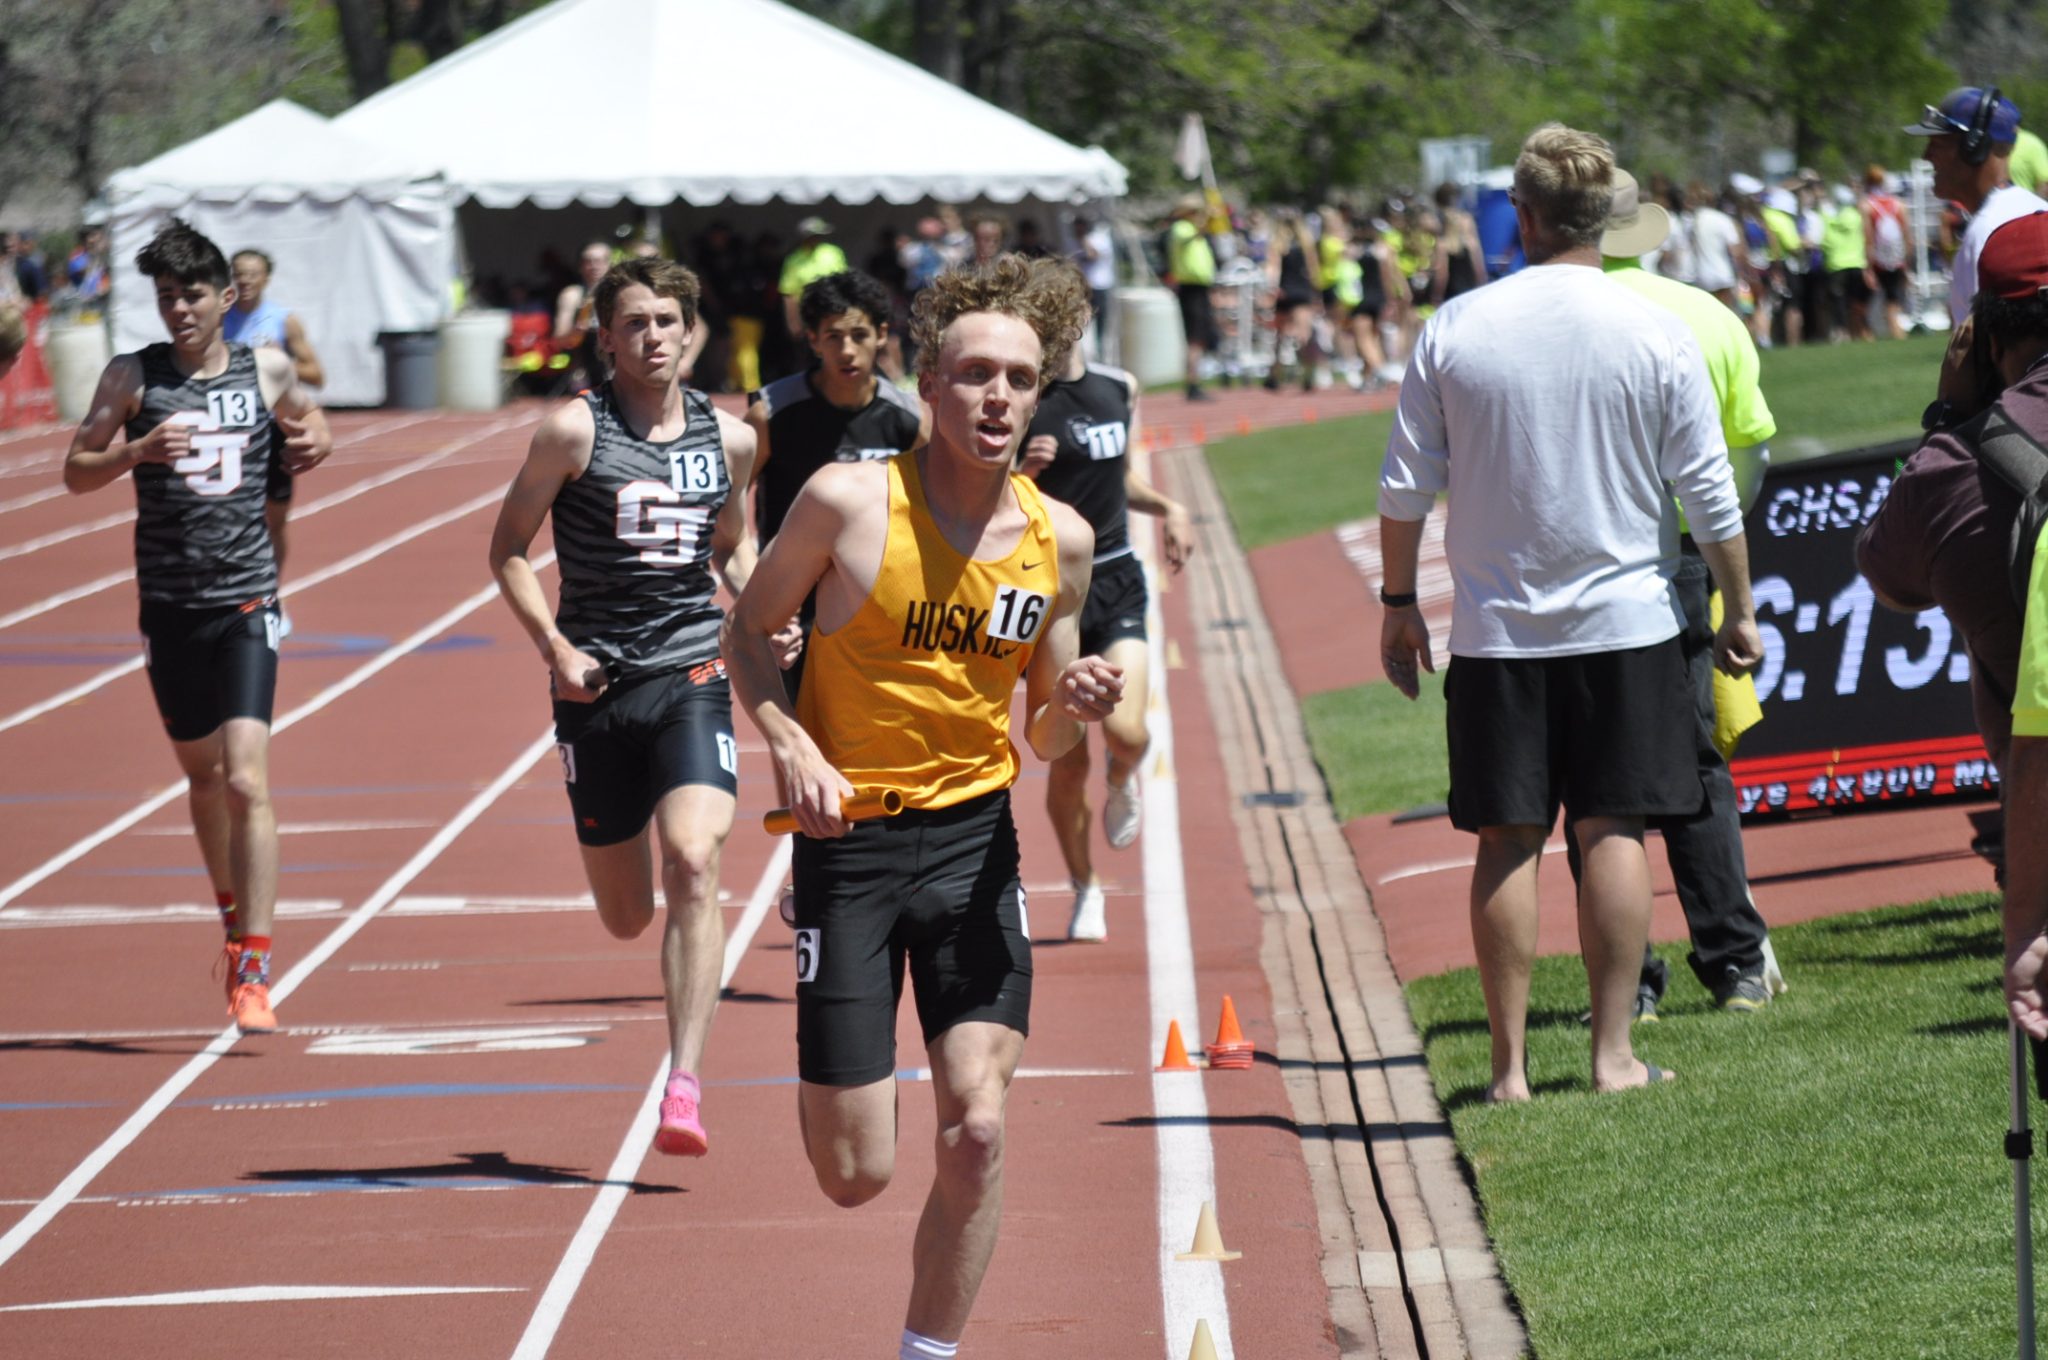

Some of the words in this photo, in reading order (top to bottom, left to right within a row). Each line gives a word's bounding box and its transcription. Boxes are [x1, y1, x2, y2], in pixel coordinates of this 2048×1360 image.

[212, 393, 249, 424] 13
[675, 454, 711, 489] 13
[900, 600, 1022, 660] HUSK
[999, 588, 1046, 641] 16
